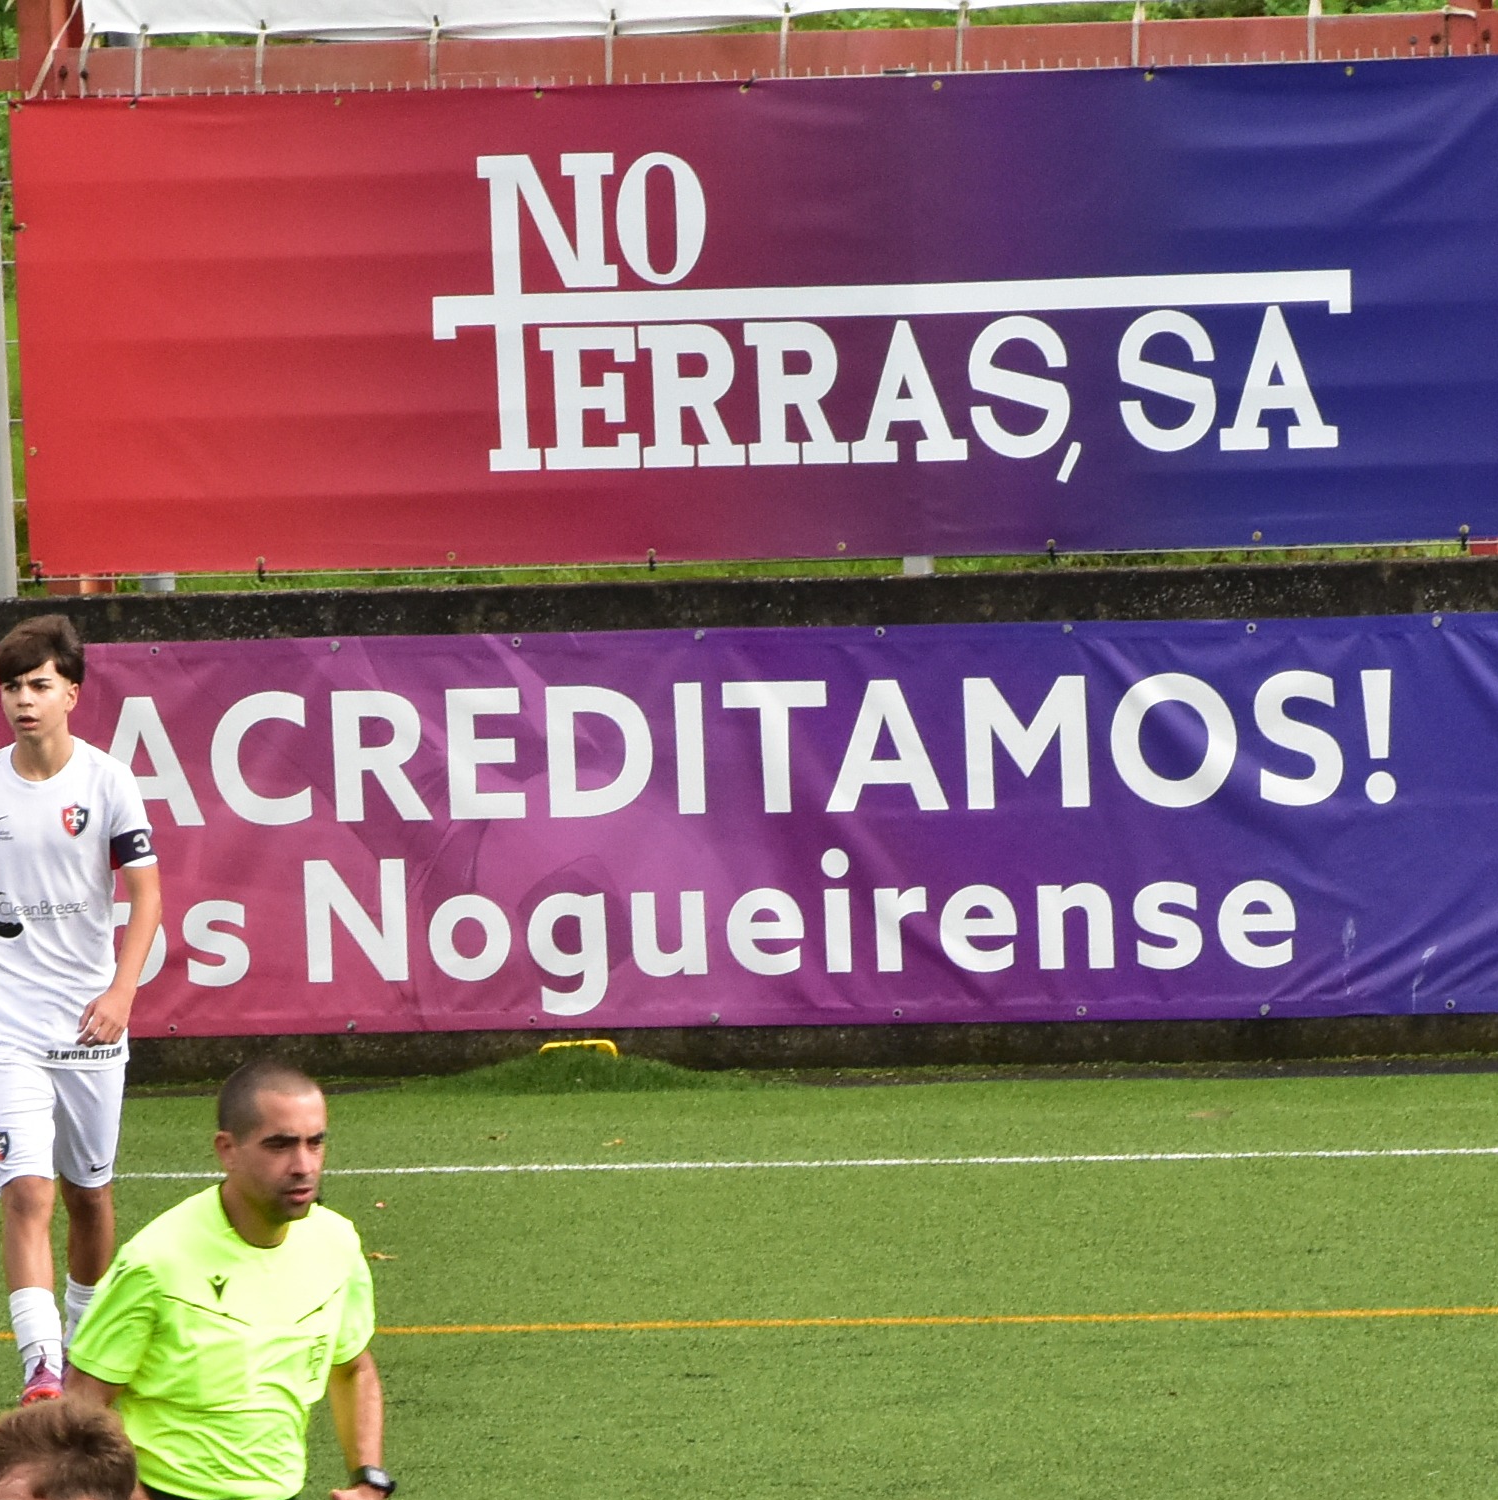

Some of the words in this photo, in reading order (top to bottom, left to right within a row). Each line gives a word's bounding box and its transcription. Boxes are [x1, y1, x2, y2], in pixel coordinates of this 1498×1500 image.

[477, 152, 706, 290] NO
[1118, 305, 1339, 452] SA
[109, 669, 1397, 827] ACREDITAMOS!
[304, 848, 1297, 1017] Nogueirense
